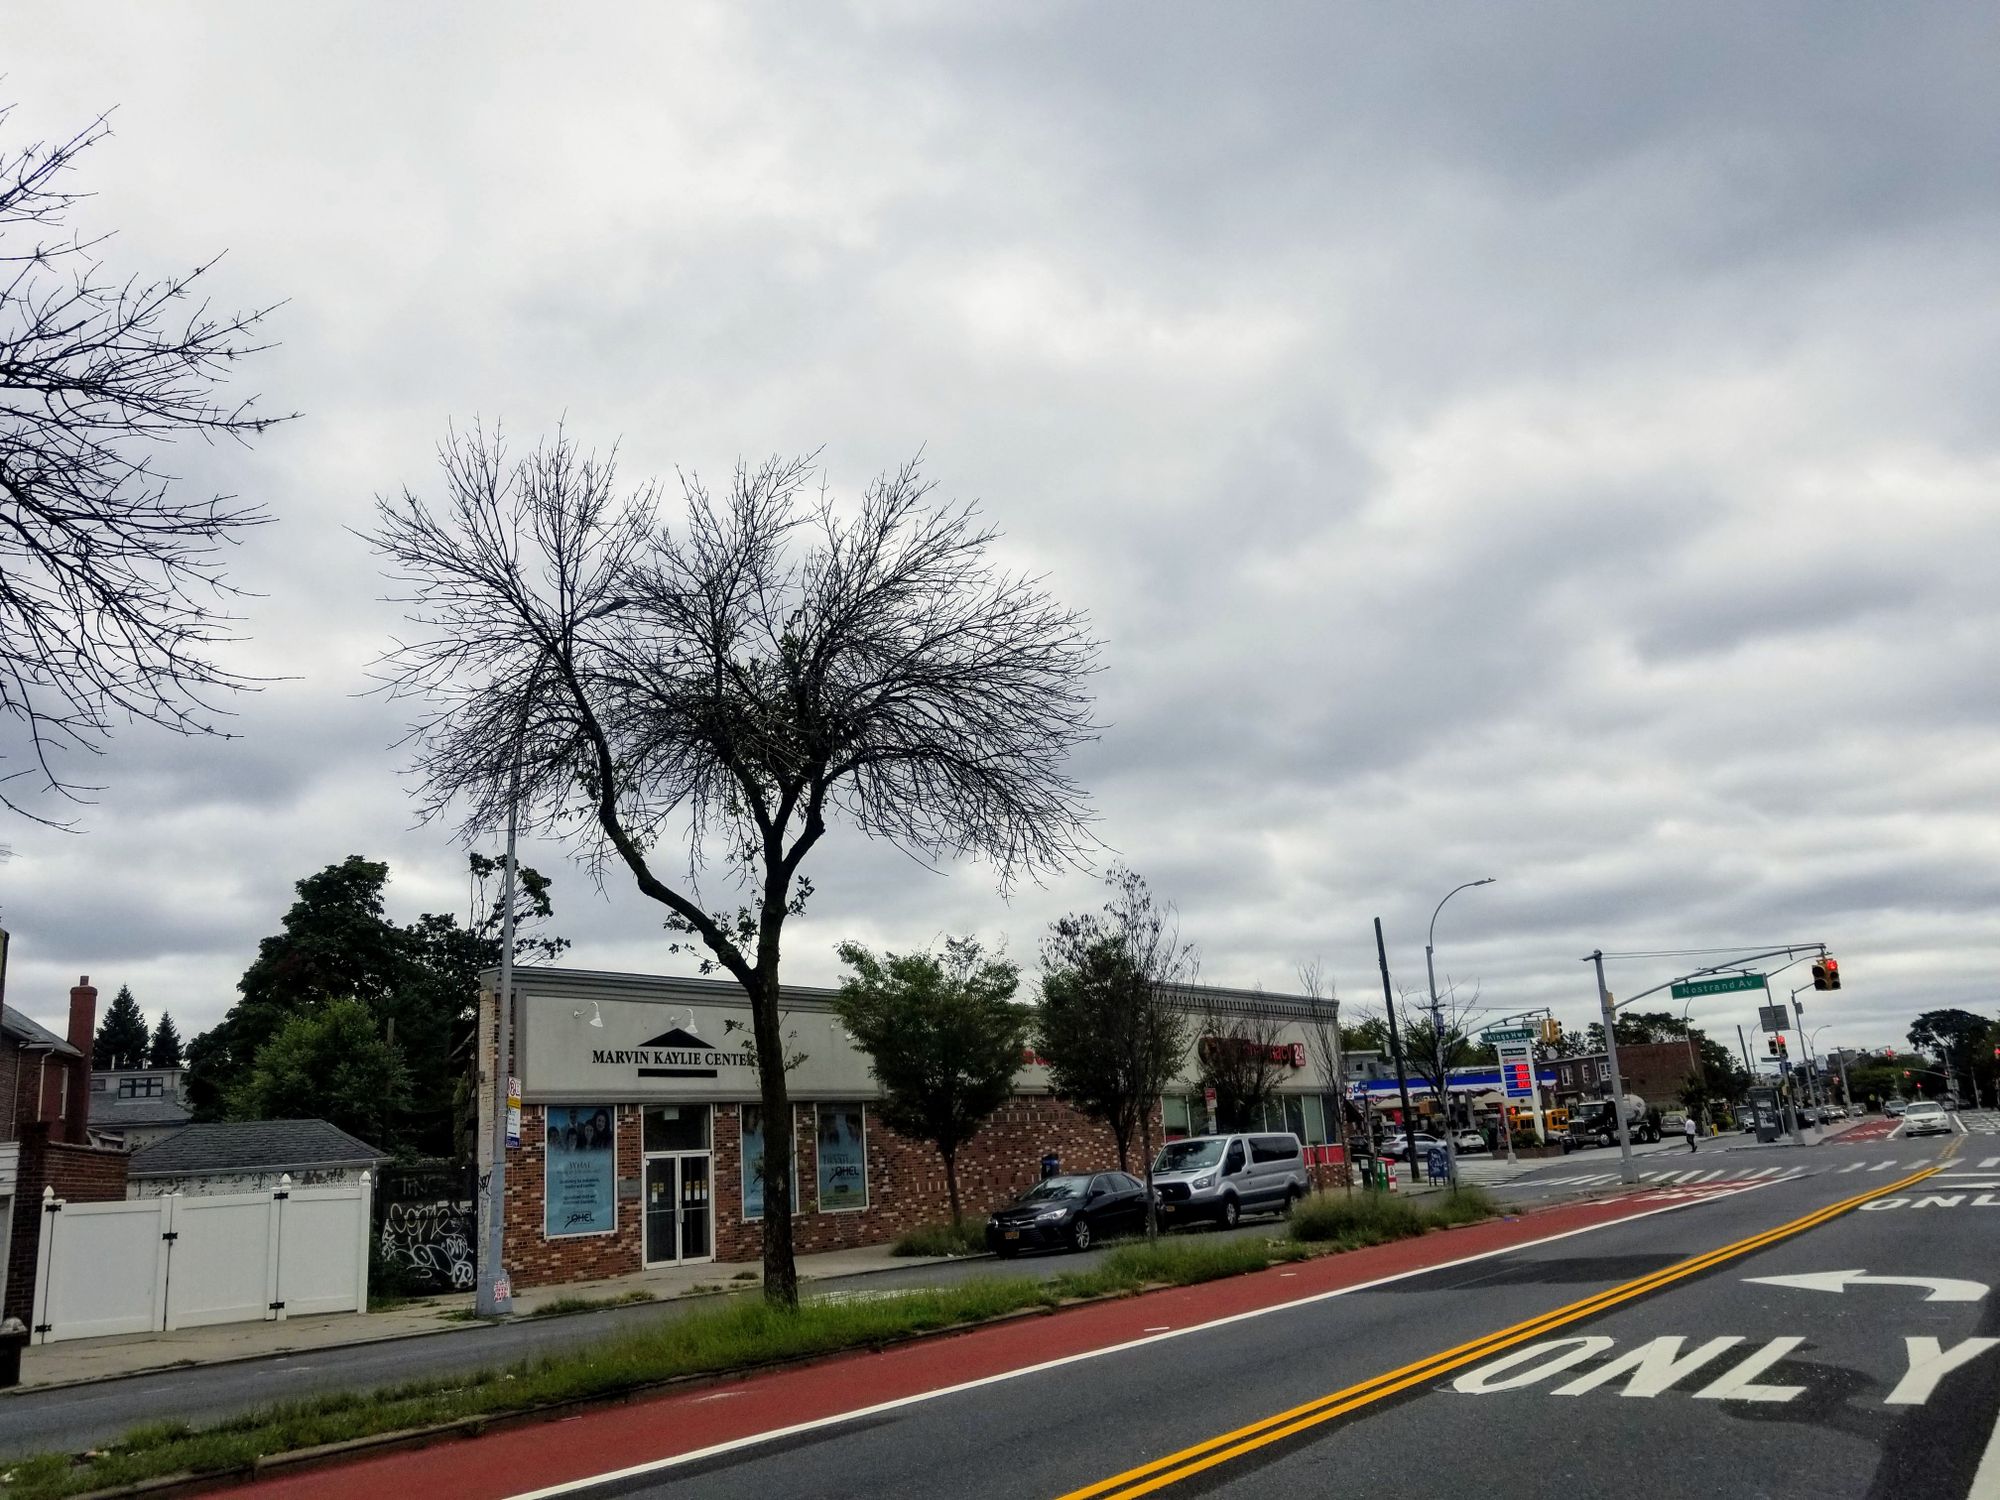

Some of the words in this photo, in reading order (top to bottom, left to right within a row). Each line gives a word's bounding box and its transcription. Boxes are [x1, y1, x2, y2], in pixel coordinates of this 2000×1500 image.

[1682, 980, 1735, 995] Nostrand
[1738, 980, 1753, 988] Av
[592, 1050, 649, 1065] MARVIN
[654, 1051, 702, 1066] KAYLIE
[1294, 1044, 1304, 1060] 24
[1452, 1336, 2000, 1405] ONLY
